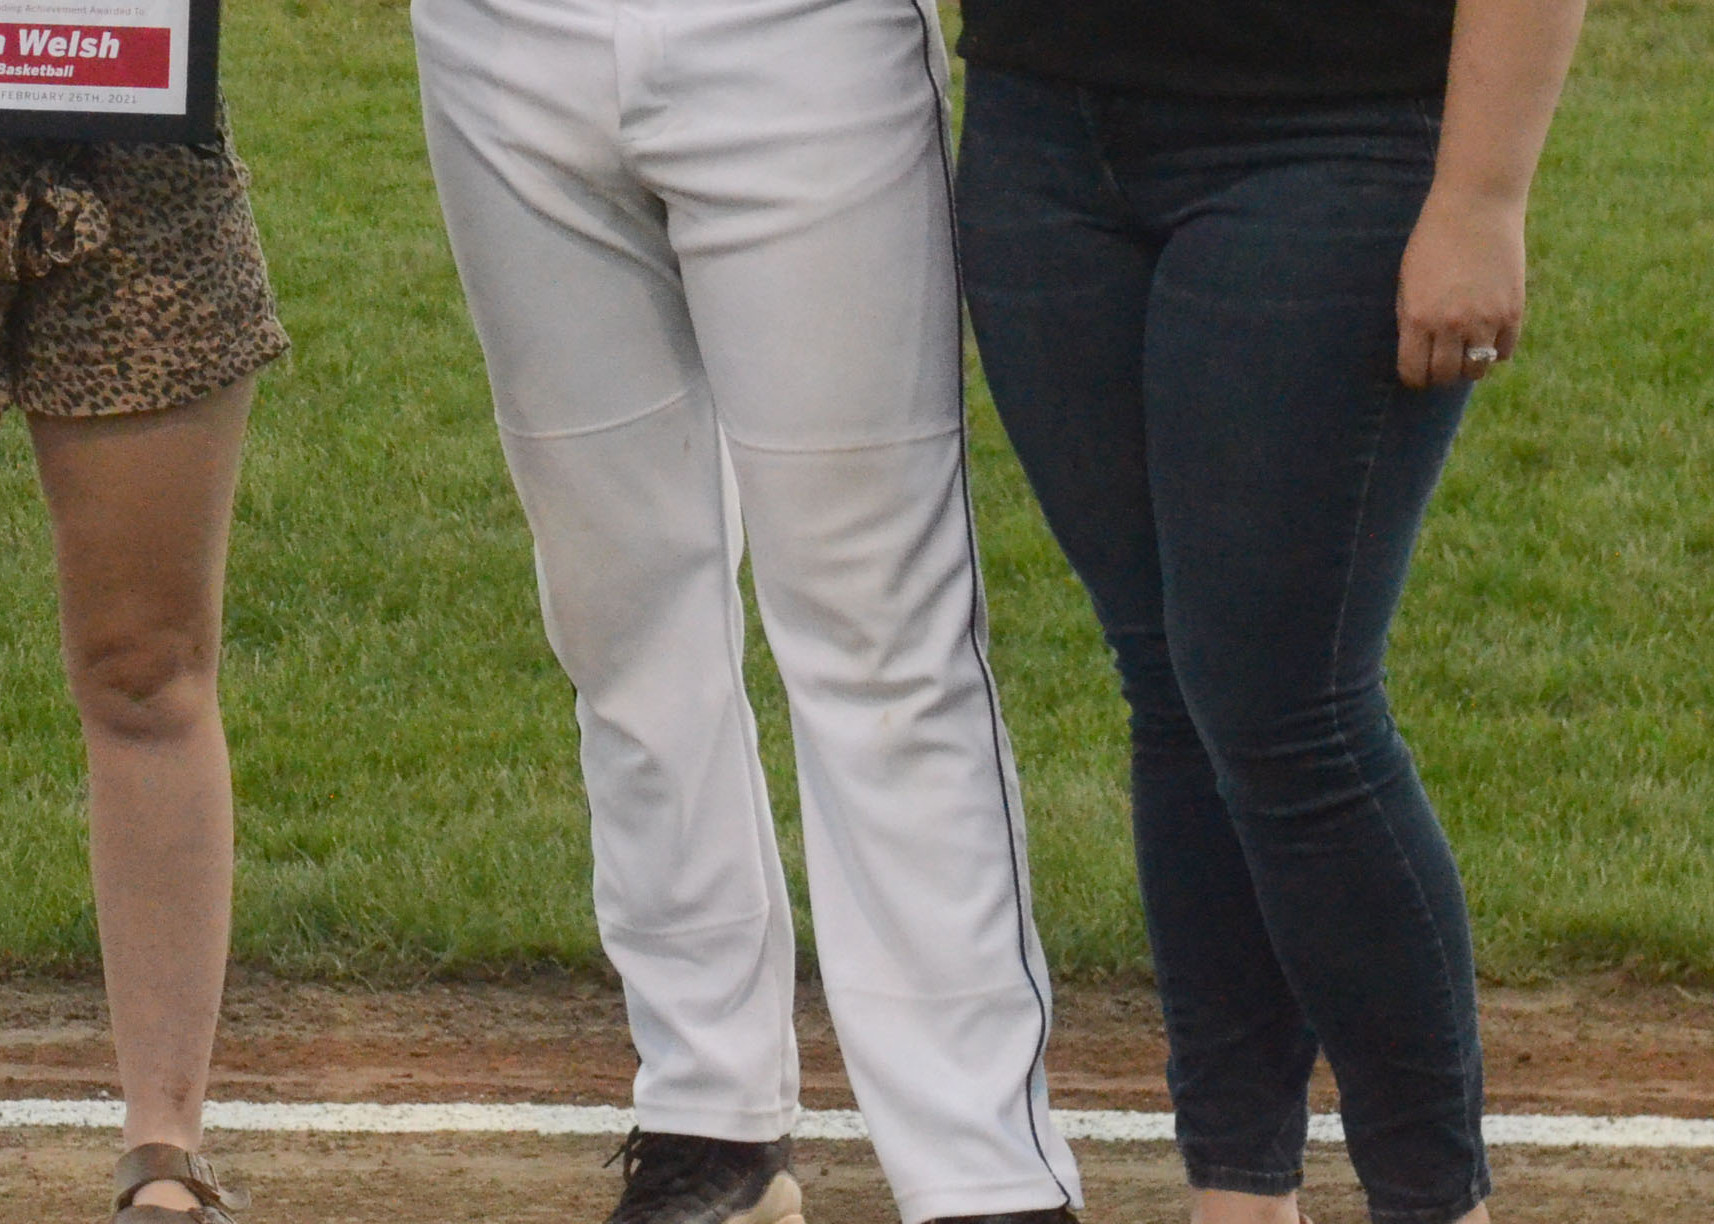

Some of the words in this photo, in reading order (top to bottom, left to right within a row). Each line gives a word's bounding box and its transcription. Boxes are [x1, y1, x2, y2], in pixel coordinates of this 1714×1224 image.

[18, 28, 121, 59] Welsh
[1, 90, 65, 102] FEBRUARY
[108, 94, 137, 105] 2021
